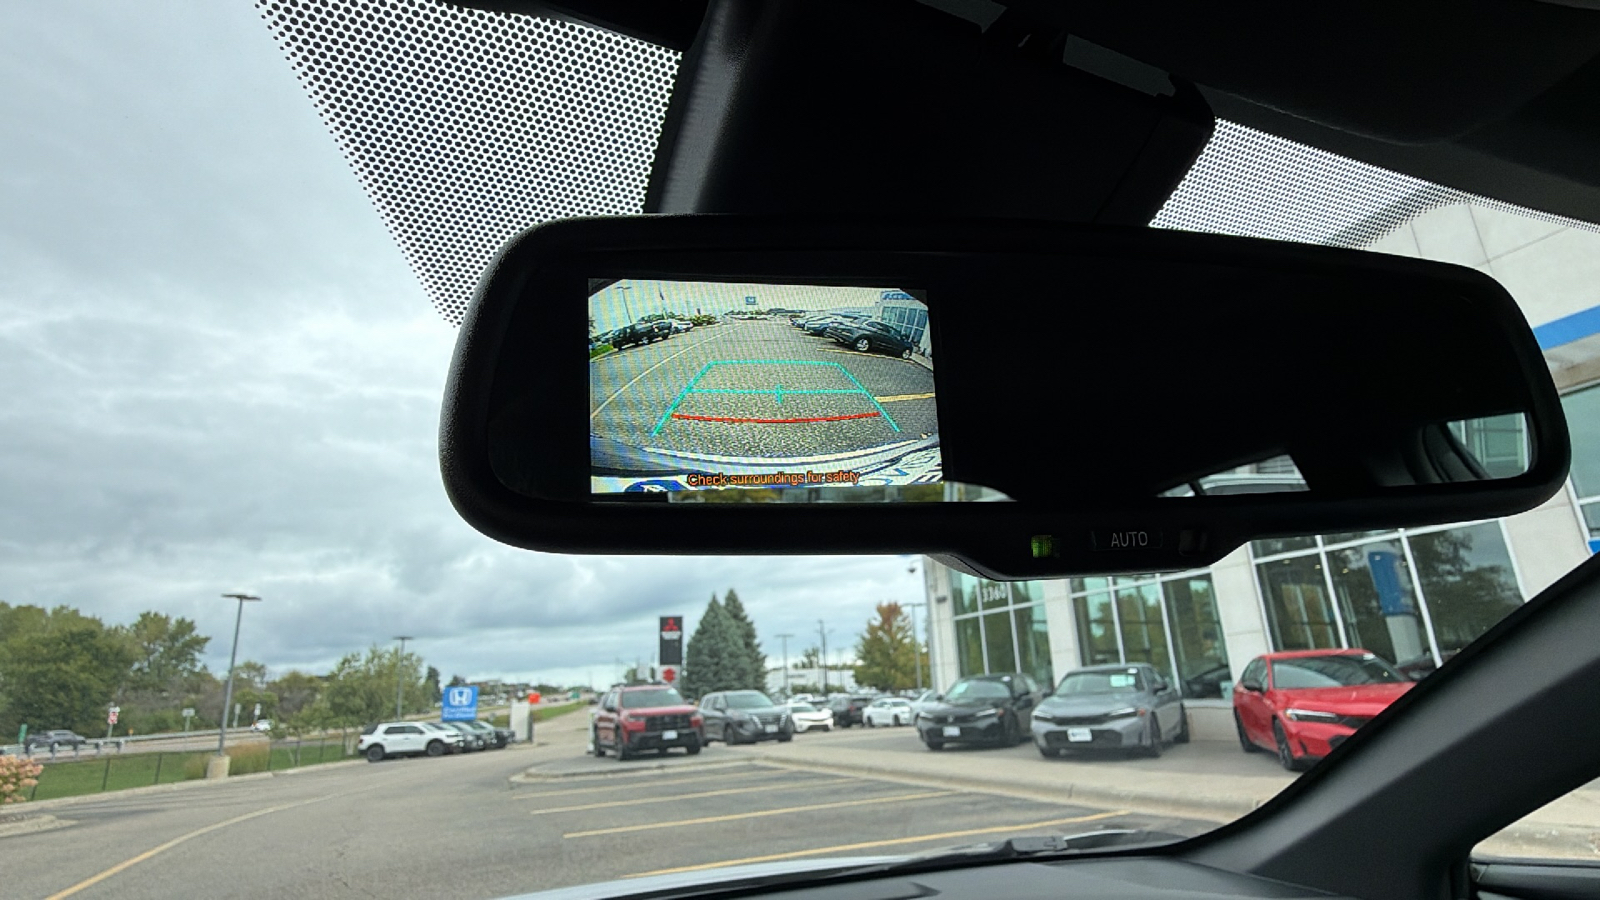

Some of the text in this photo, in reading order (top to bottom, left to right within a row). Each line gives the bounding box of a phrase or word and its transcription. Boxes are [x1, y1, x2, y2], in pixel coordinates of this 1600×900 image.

[688, 471, 860, 486] Check surroundings for safety
[1110, 531, 1148, 548] AUTO
